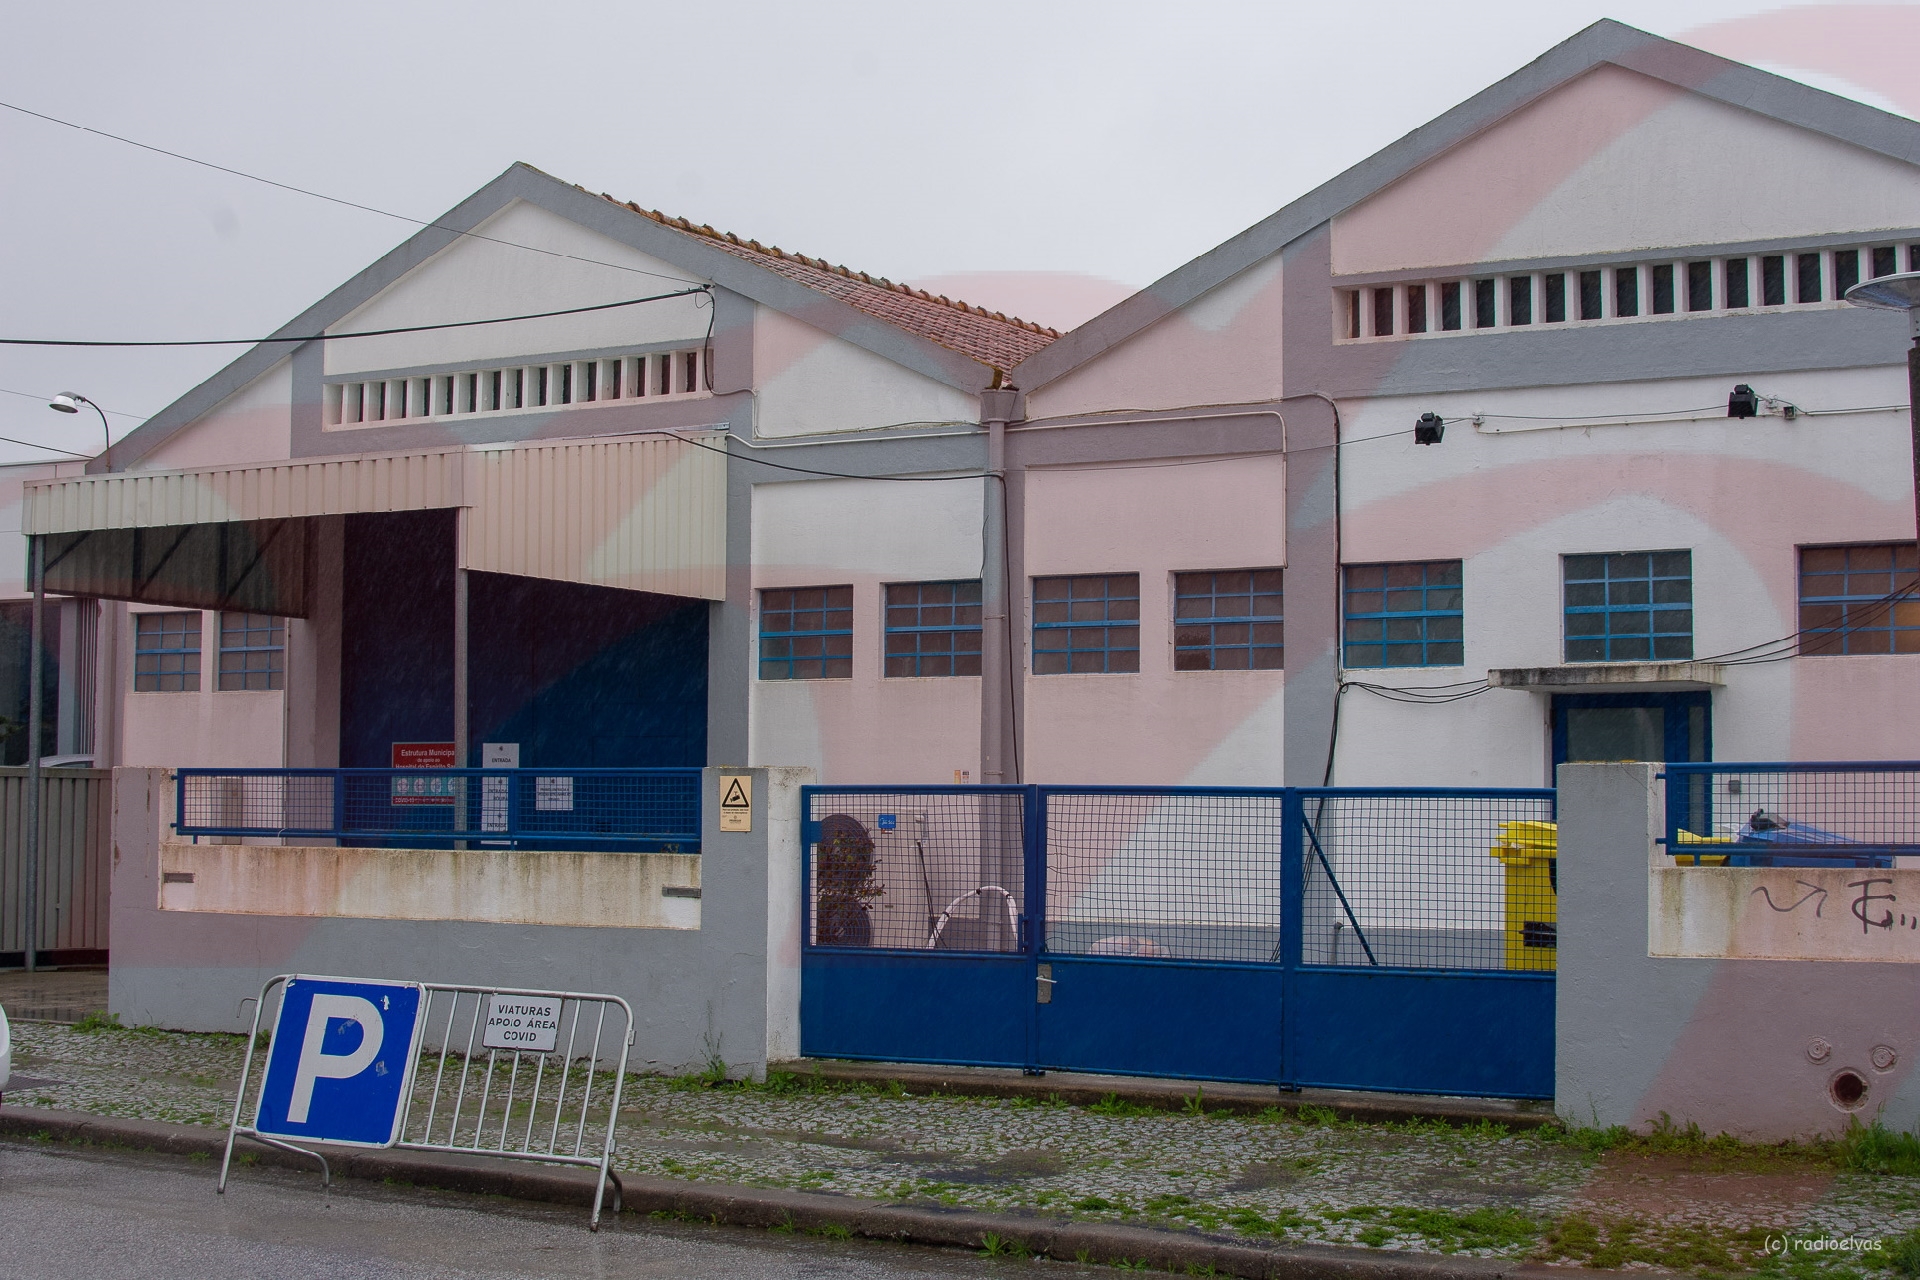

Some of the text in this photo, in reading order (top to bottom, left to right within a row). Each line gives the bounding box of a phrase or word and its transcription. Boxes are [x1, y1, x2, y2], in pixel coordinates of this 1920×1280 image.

[401, 749, 455, 758] Estrutura Municipa
[498, 1005, 552, 1017] VIATURAS
[487, 1017, 556, 1029] APOIO ÁREA
[503, 1030, 537, 1042] COVID
[286, 993, 385, 1124] P
